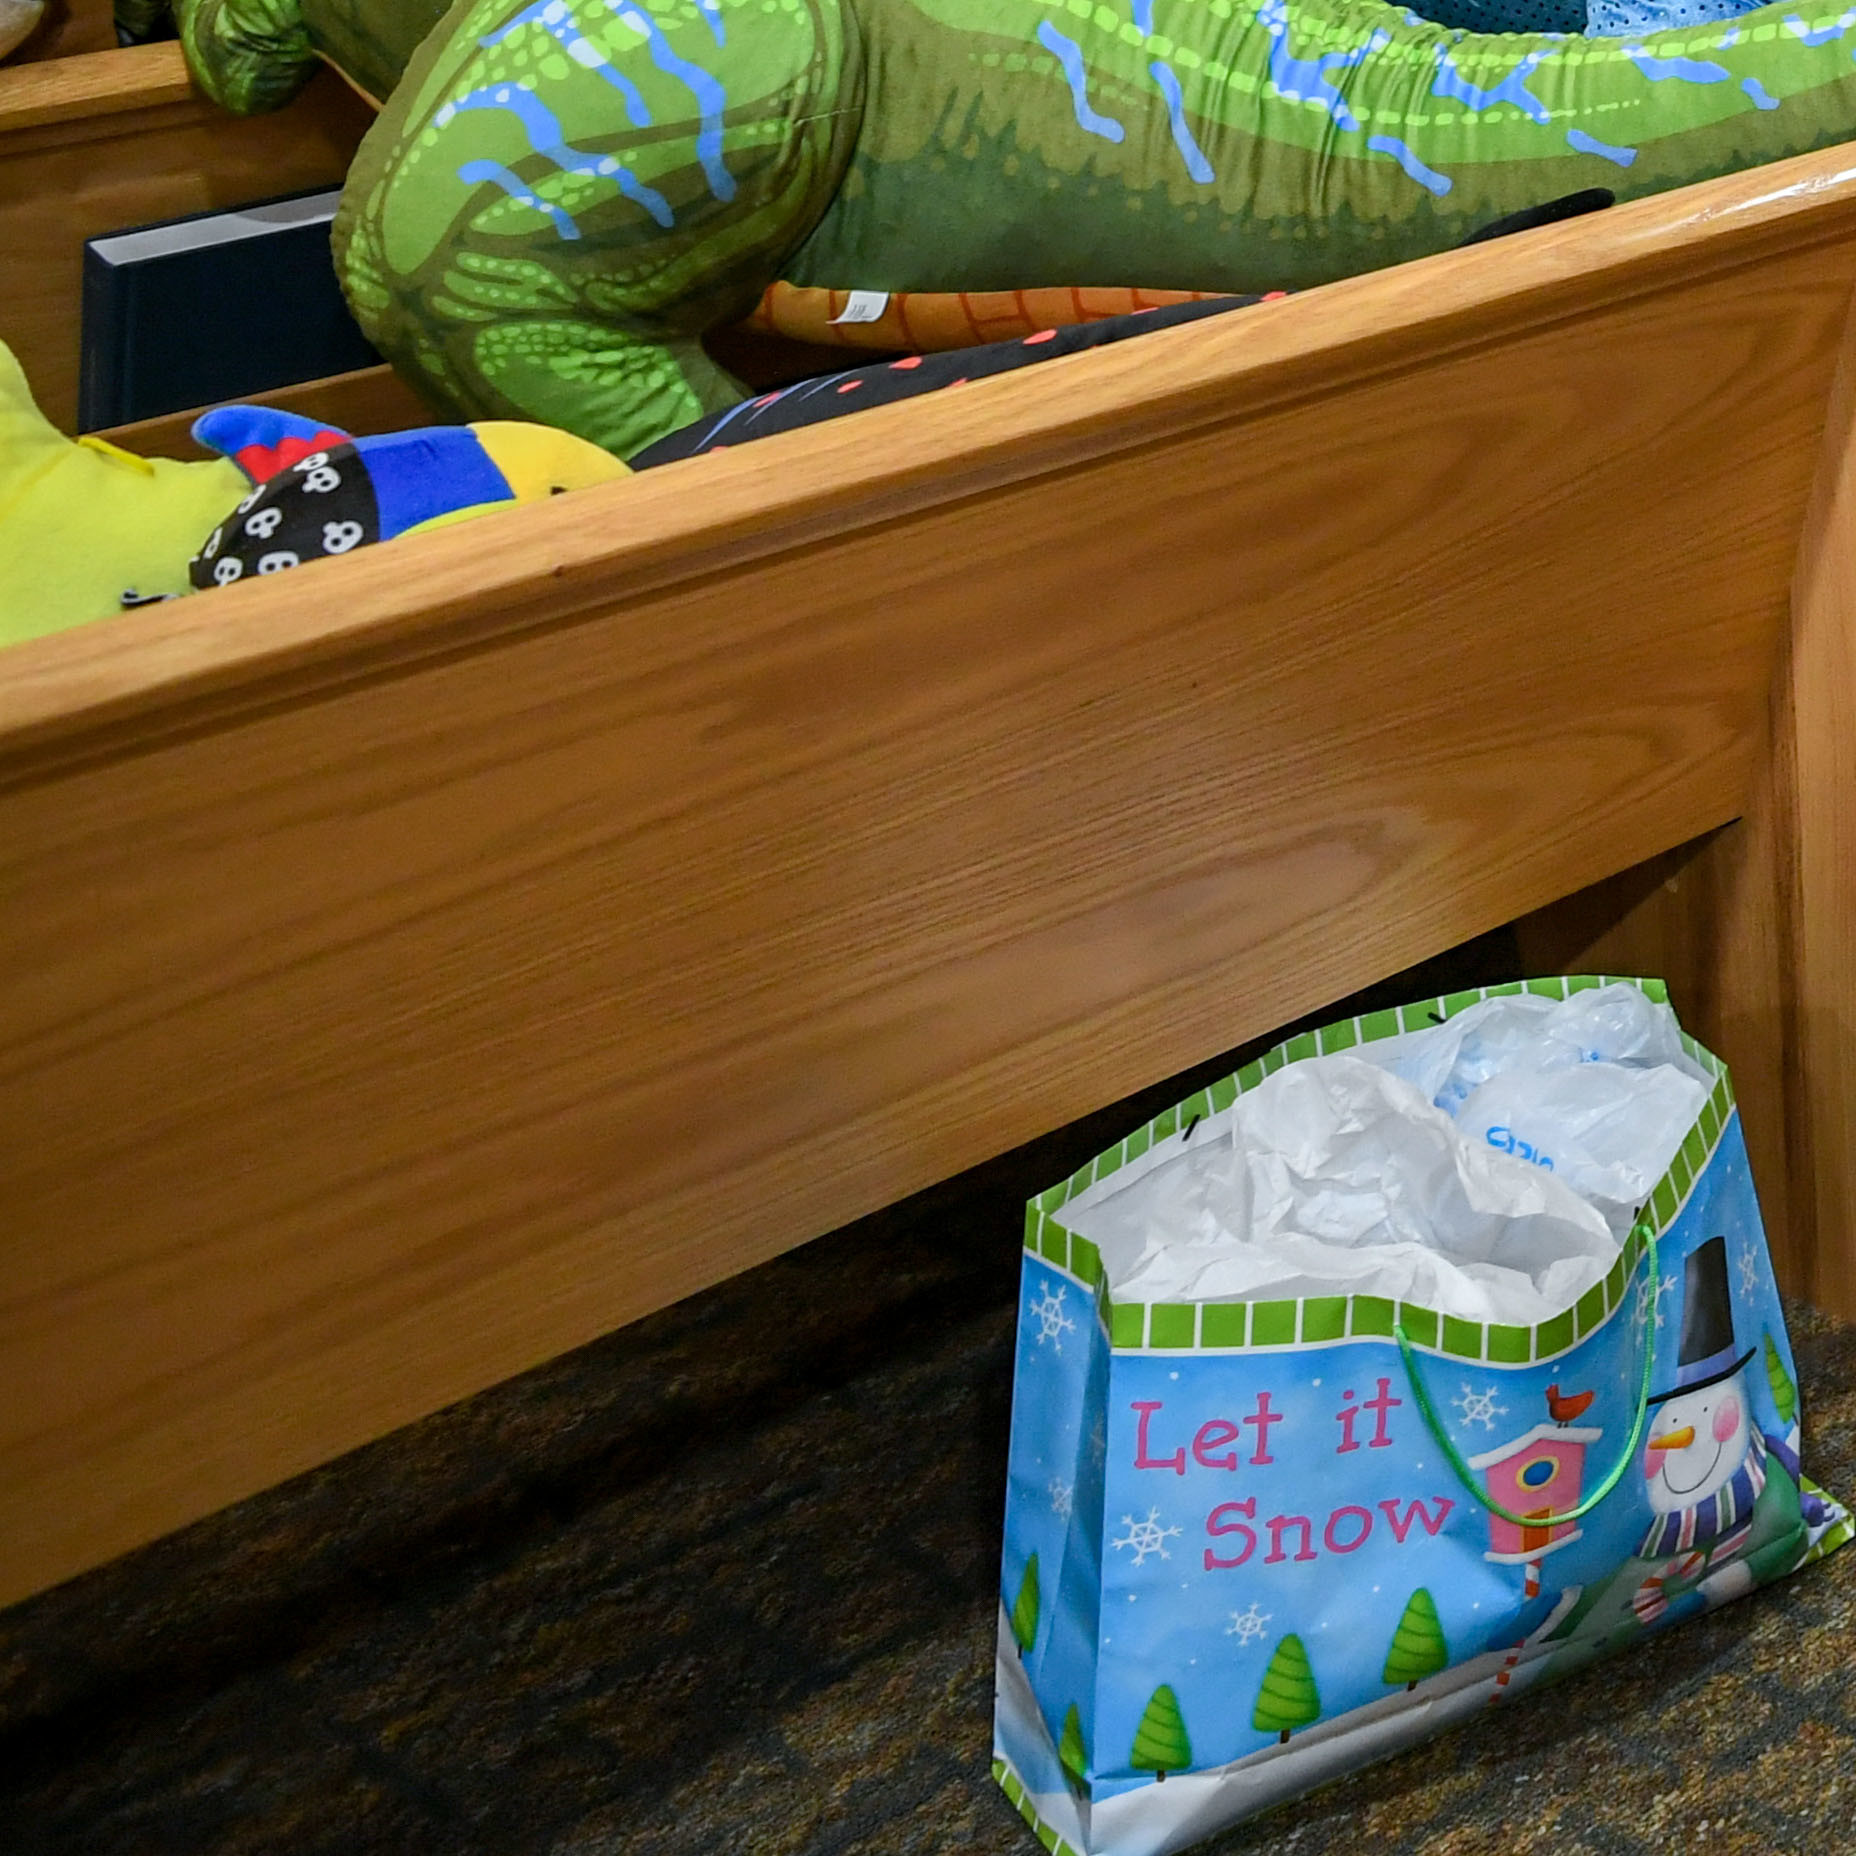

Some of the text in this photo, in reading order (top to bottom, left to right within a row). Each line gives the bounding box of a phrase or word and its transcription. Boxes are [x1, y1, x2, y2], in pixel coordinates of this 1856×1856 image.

[1130, 1377, 1402, 1476] Let it
[1203, 1496, 1456, 1572] Snow
